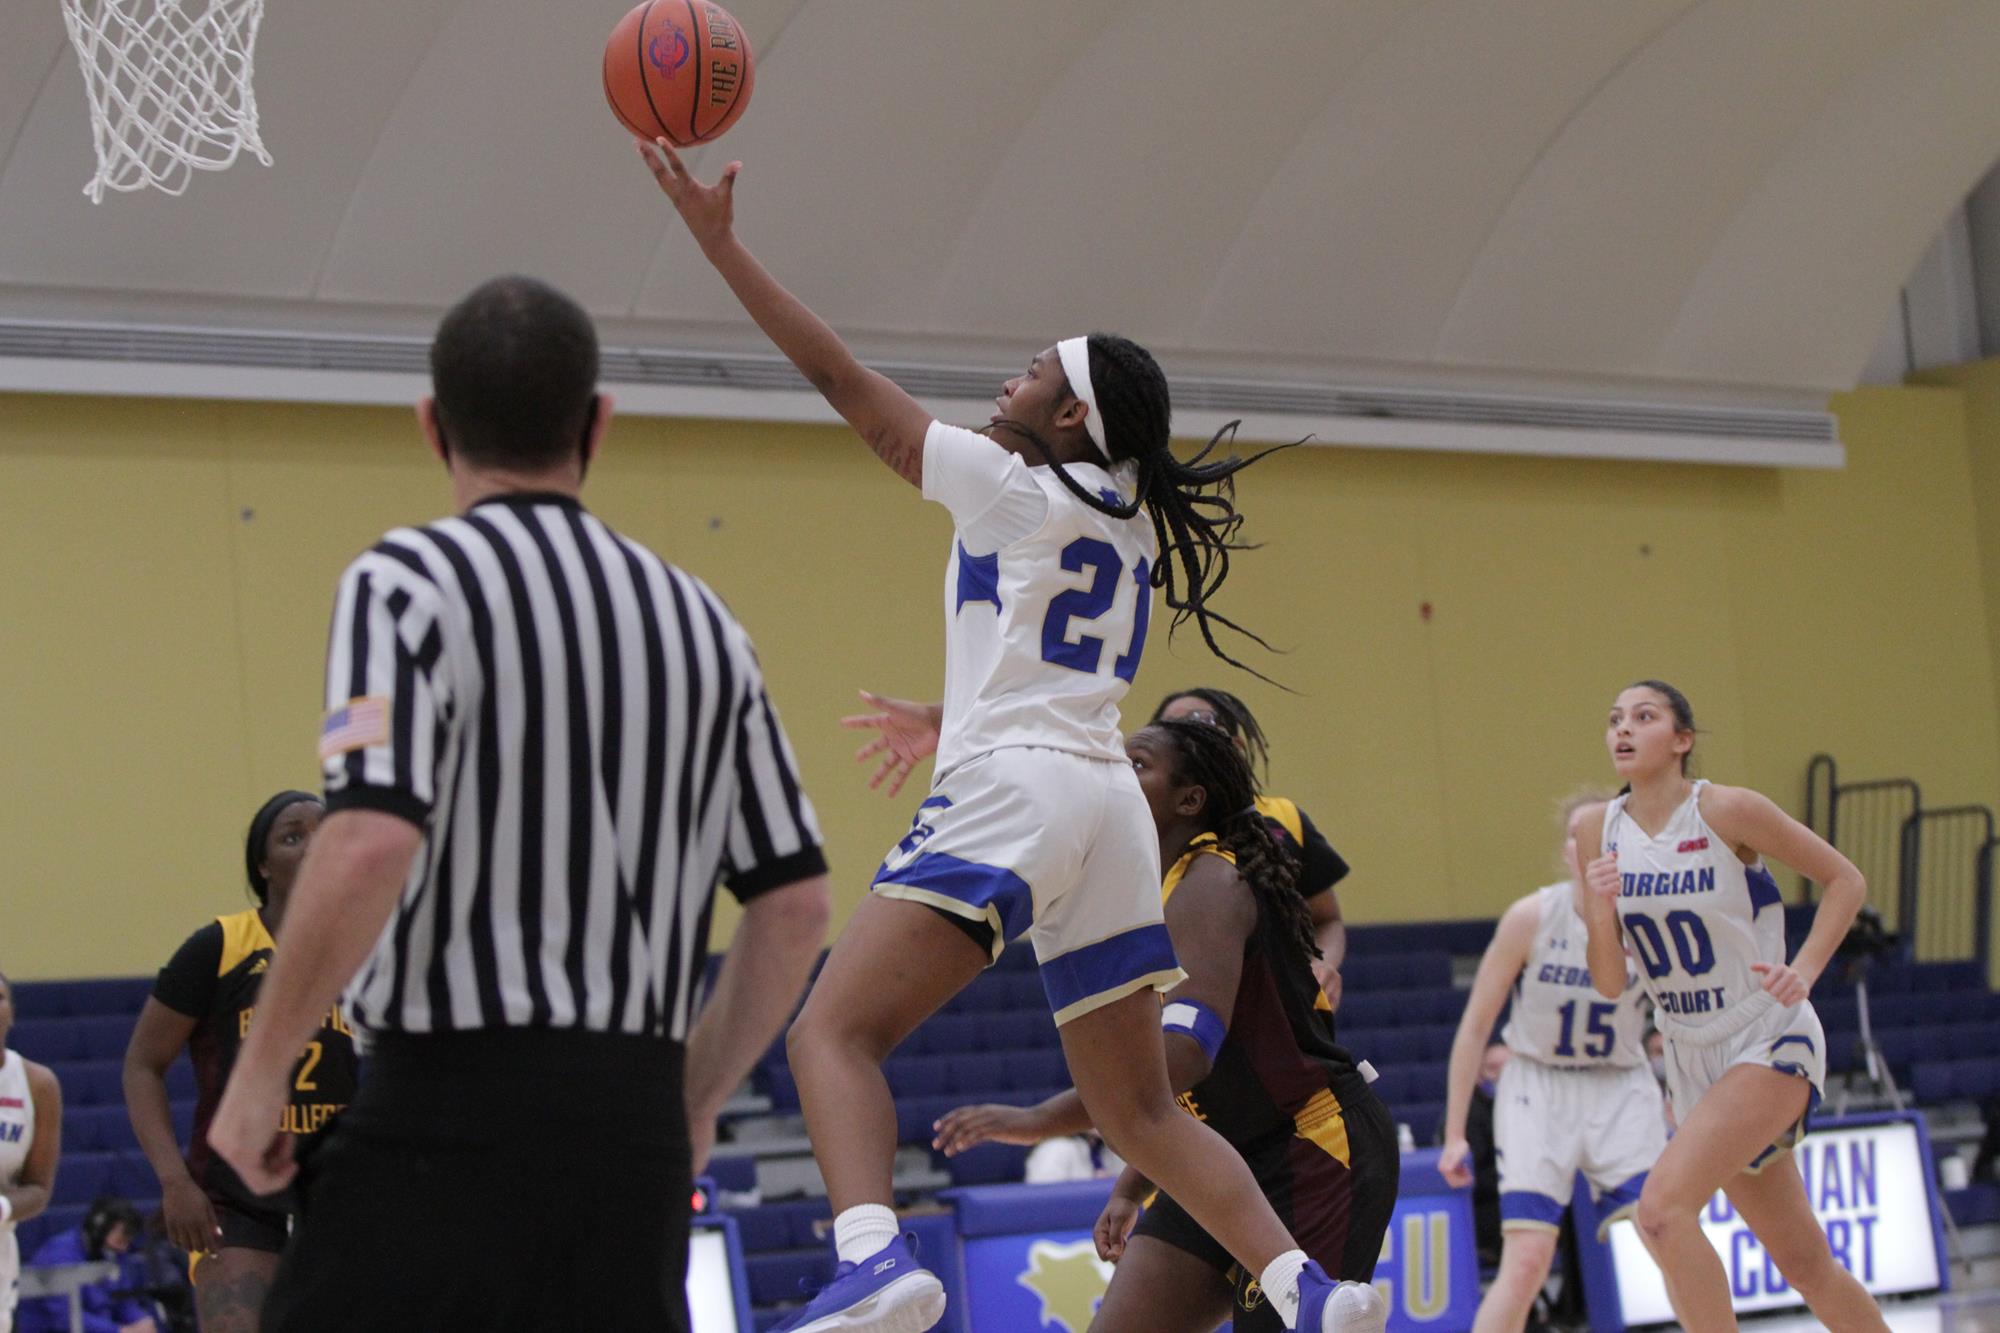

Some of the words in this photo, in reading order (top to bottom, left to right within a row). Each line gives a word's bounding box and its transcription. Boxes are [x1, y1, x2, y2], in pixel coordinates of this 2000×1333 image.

[711, 61, 737, 106] THE
[1042, 536, 1150, 685] 21
[1618, 866, 1714, 897] ORGIAN
[1623, 910, 1716, 978] 00
[1658, 986, 1725, 1014] COURT
[1554, 1000, 1617, 1057] 15
[295, 1040, 322, 1091] 2
[1731, 1215, 1877, 1298] CRT
